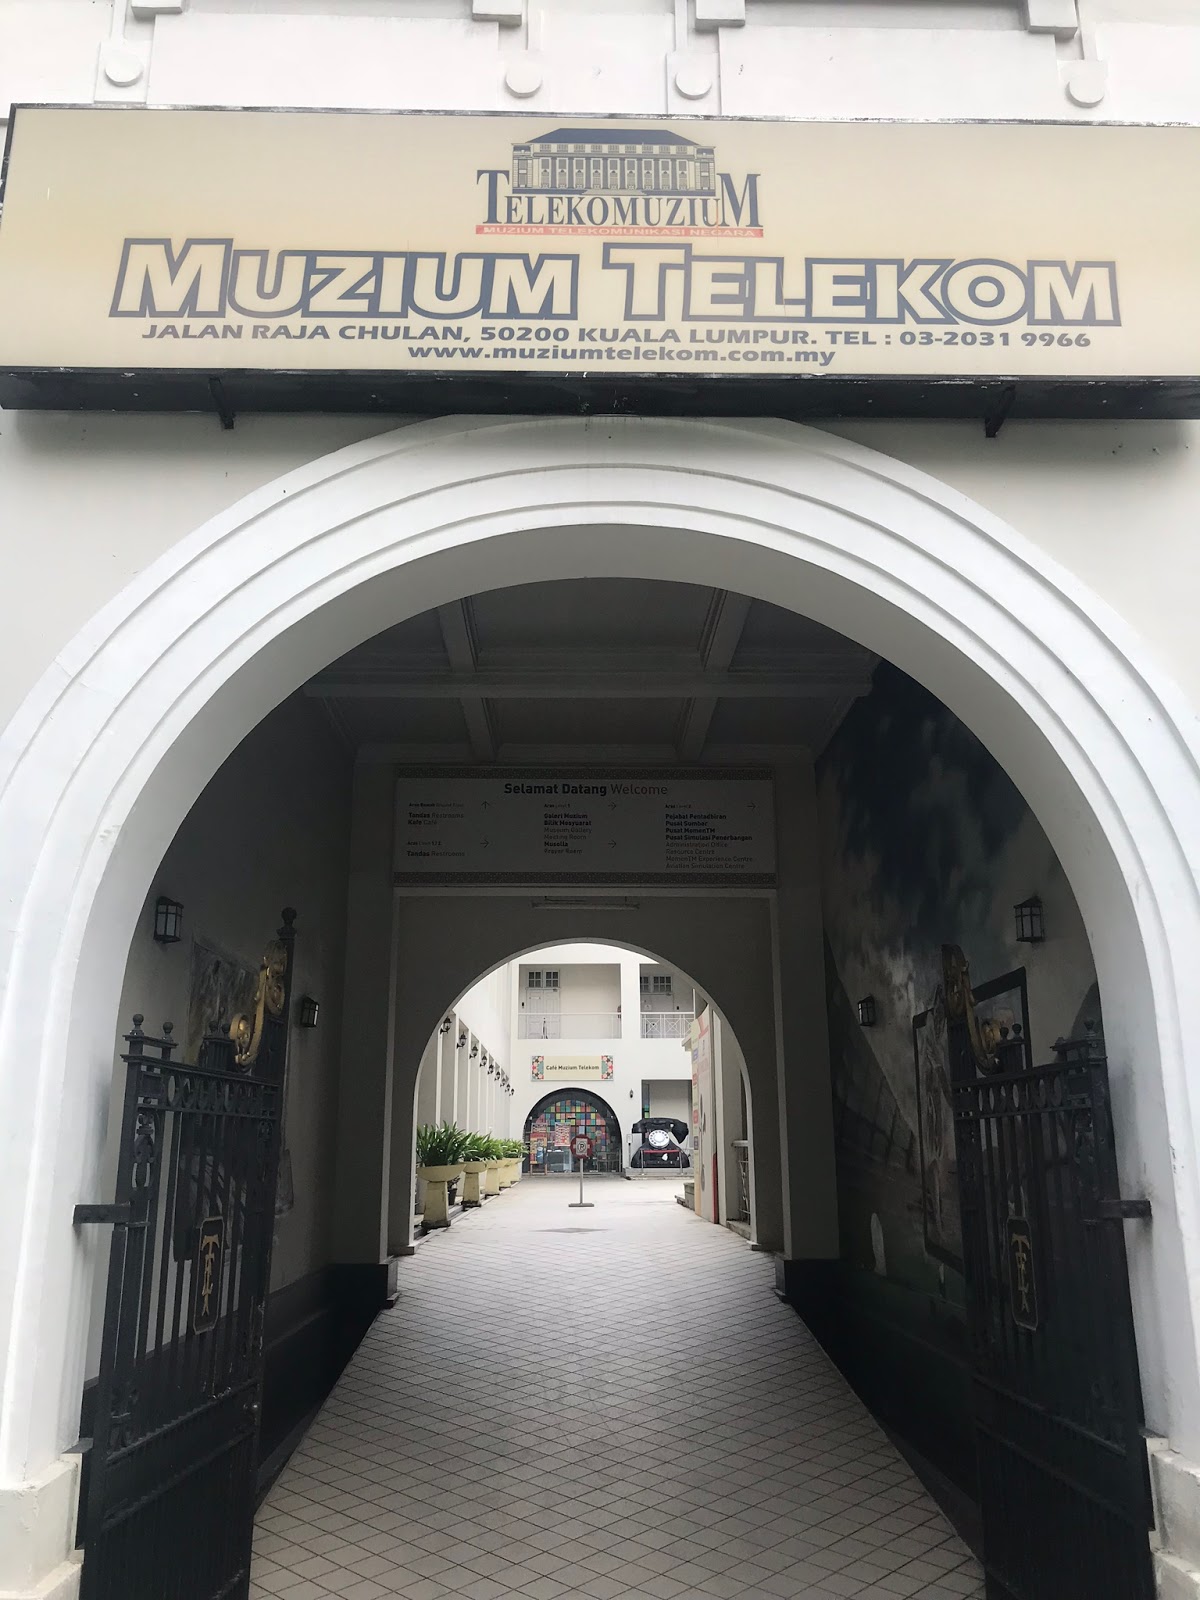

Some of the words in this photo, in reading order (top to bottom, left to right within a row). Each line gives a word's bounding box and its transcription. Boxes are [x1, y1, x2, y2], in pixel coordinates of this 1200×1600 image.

[476, 170, 764, 228] TELEKOMUZIUM
[483, 226, 544, 234] MUZIUM
[549, 228, 685, 236] TELEKOMUNIKASI
[690, 229, 755, 237] NEGARA
[108, 238, 580, 320] MUZIUM
[602, 242, 1122, 327] TELEKOM
[142, 324, 243, 339] JALAN
[252, 325, 330, 340] RAJA
[338, 326, 472, 342] CHULAN,
[480, 326, 570, 342] 50200
[578, 328, 680, 343] KUALA
[689, 329, 817, 345] LUMPUR.
[899, 331, 1010, 346] 03-2031
[1020, 332, 1092, 348] 9966
[408, 344, 836, 366] www.muziumtelekom.com.my
[504, 783, 558, 794] Selamat
[562, 784, 607, 796] Datang
[610, 784, 668, 795] Welcome
